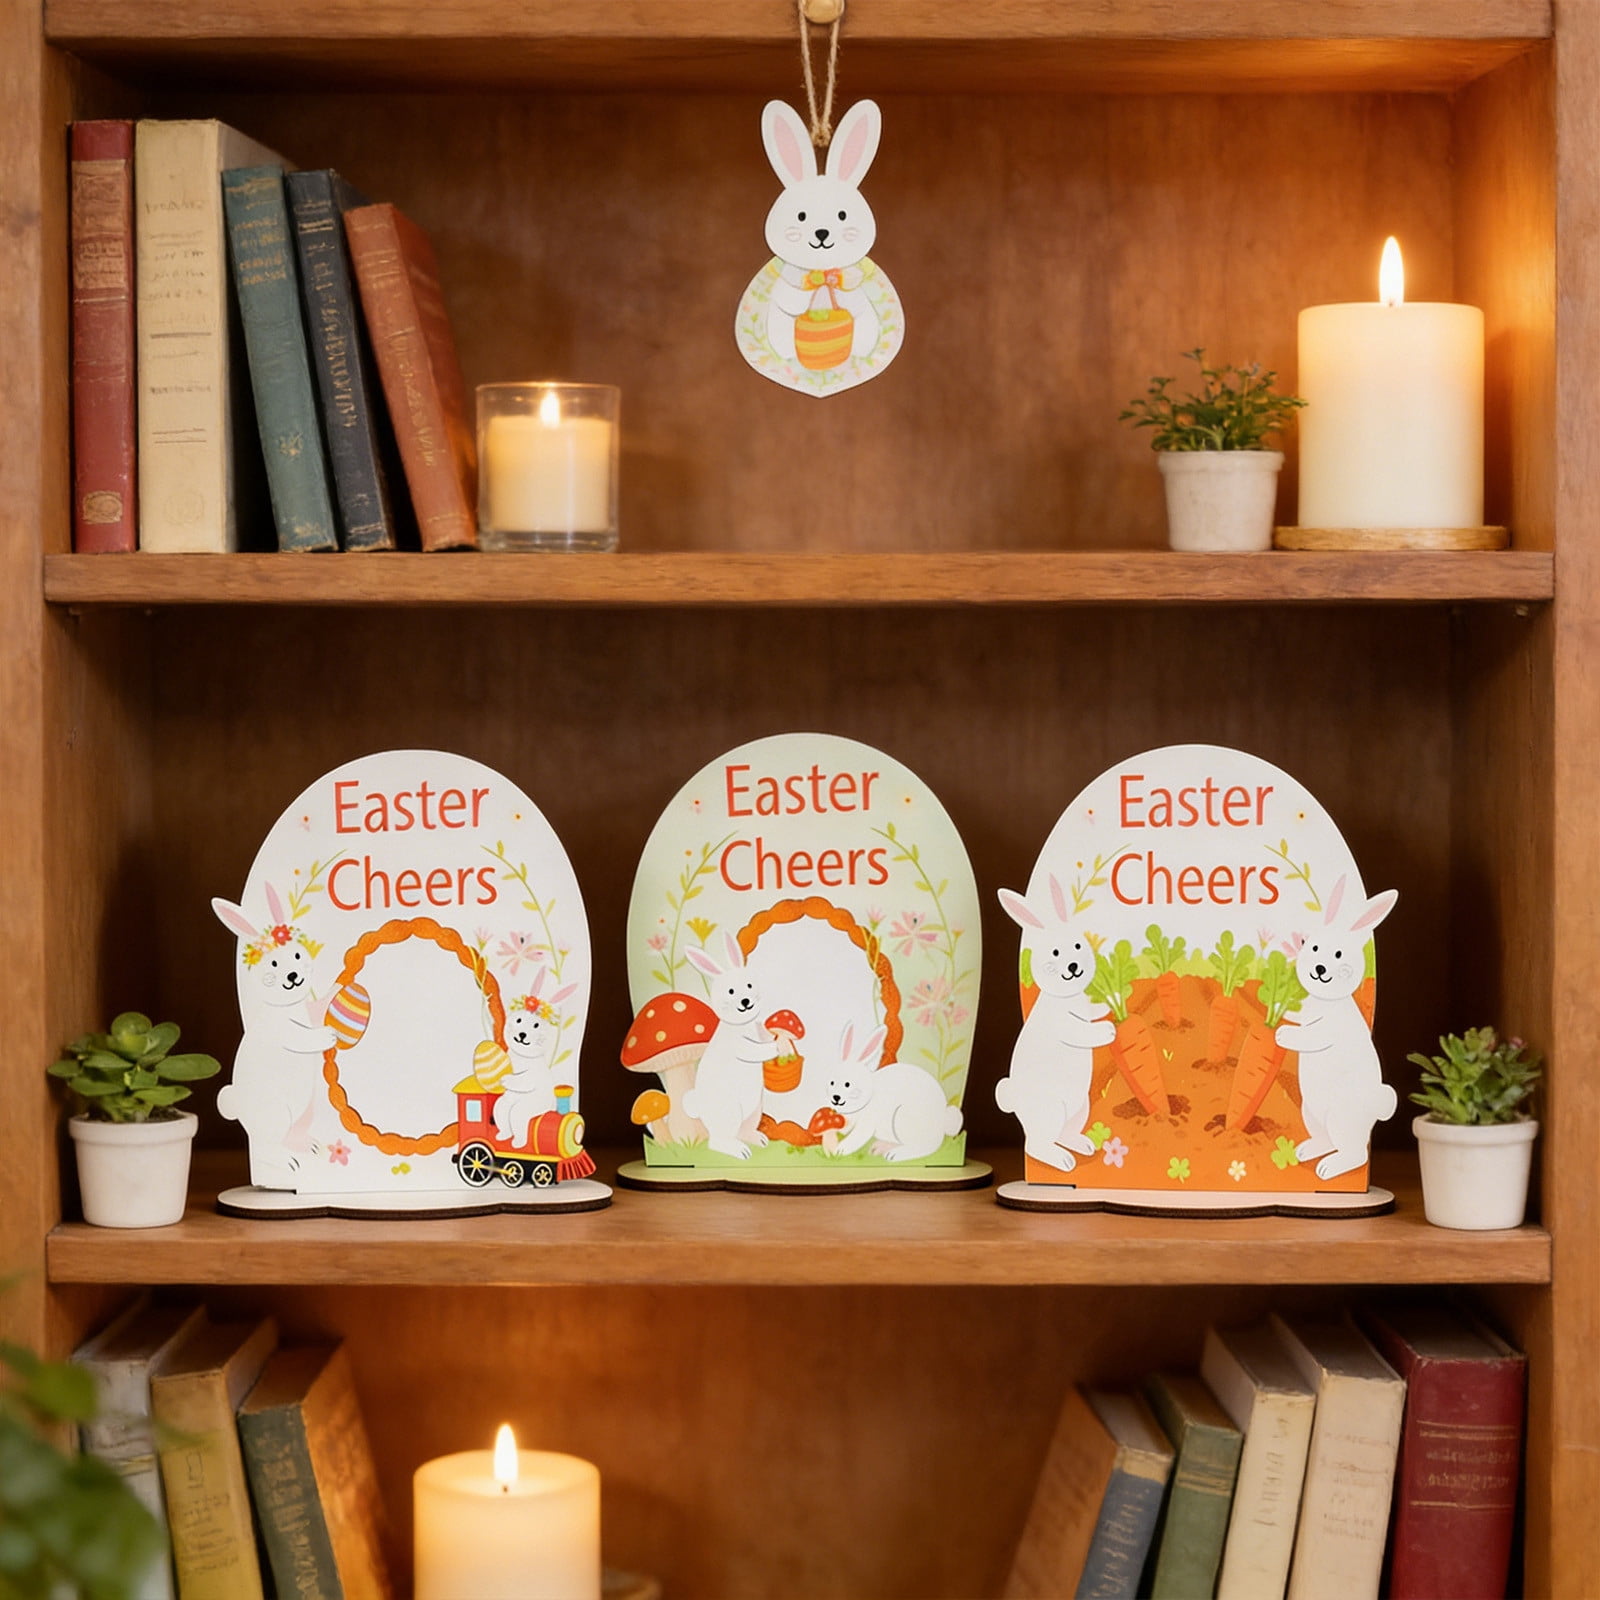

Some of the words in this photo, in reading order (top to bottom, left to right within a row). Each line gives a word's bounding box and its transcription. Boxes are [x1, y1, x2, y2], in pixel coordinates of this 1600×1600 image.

[334, 780, 490, 834] Easter
[726, 764, 880, 817] Easter
[1120, 774, 1274, 828] Easter
[327, 855, 498, 911] Cheers
[719, 836, 889, 892] Cheers
[1110, 850, 1279, 906] Cheers
